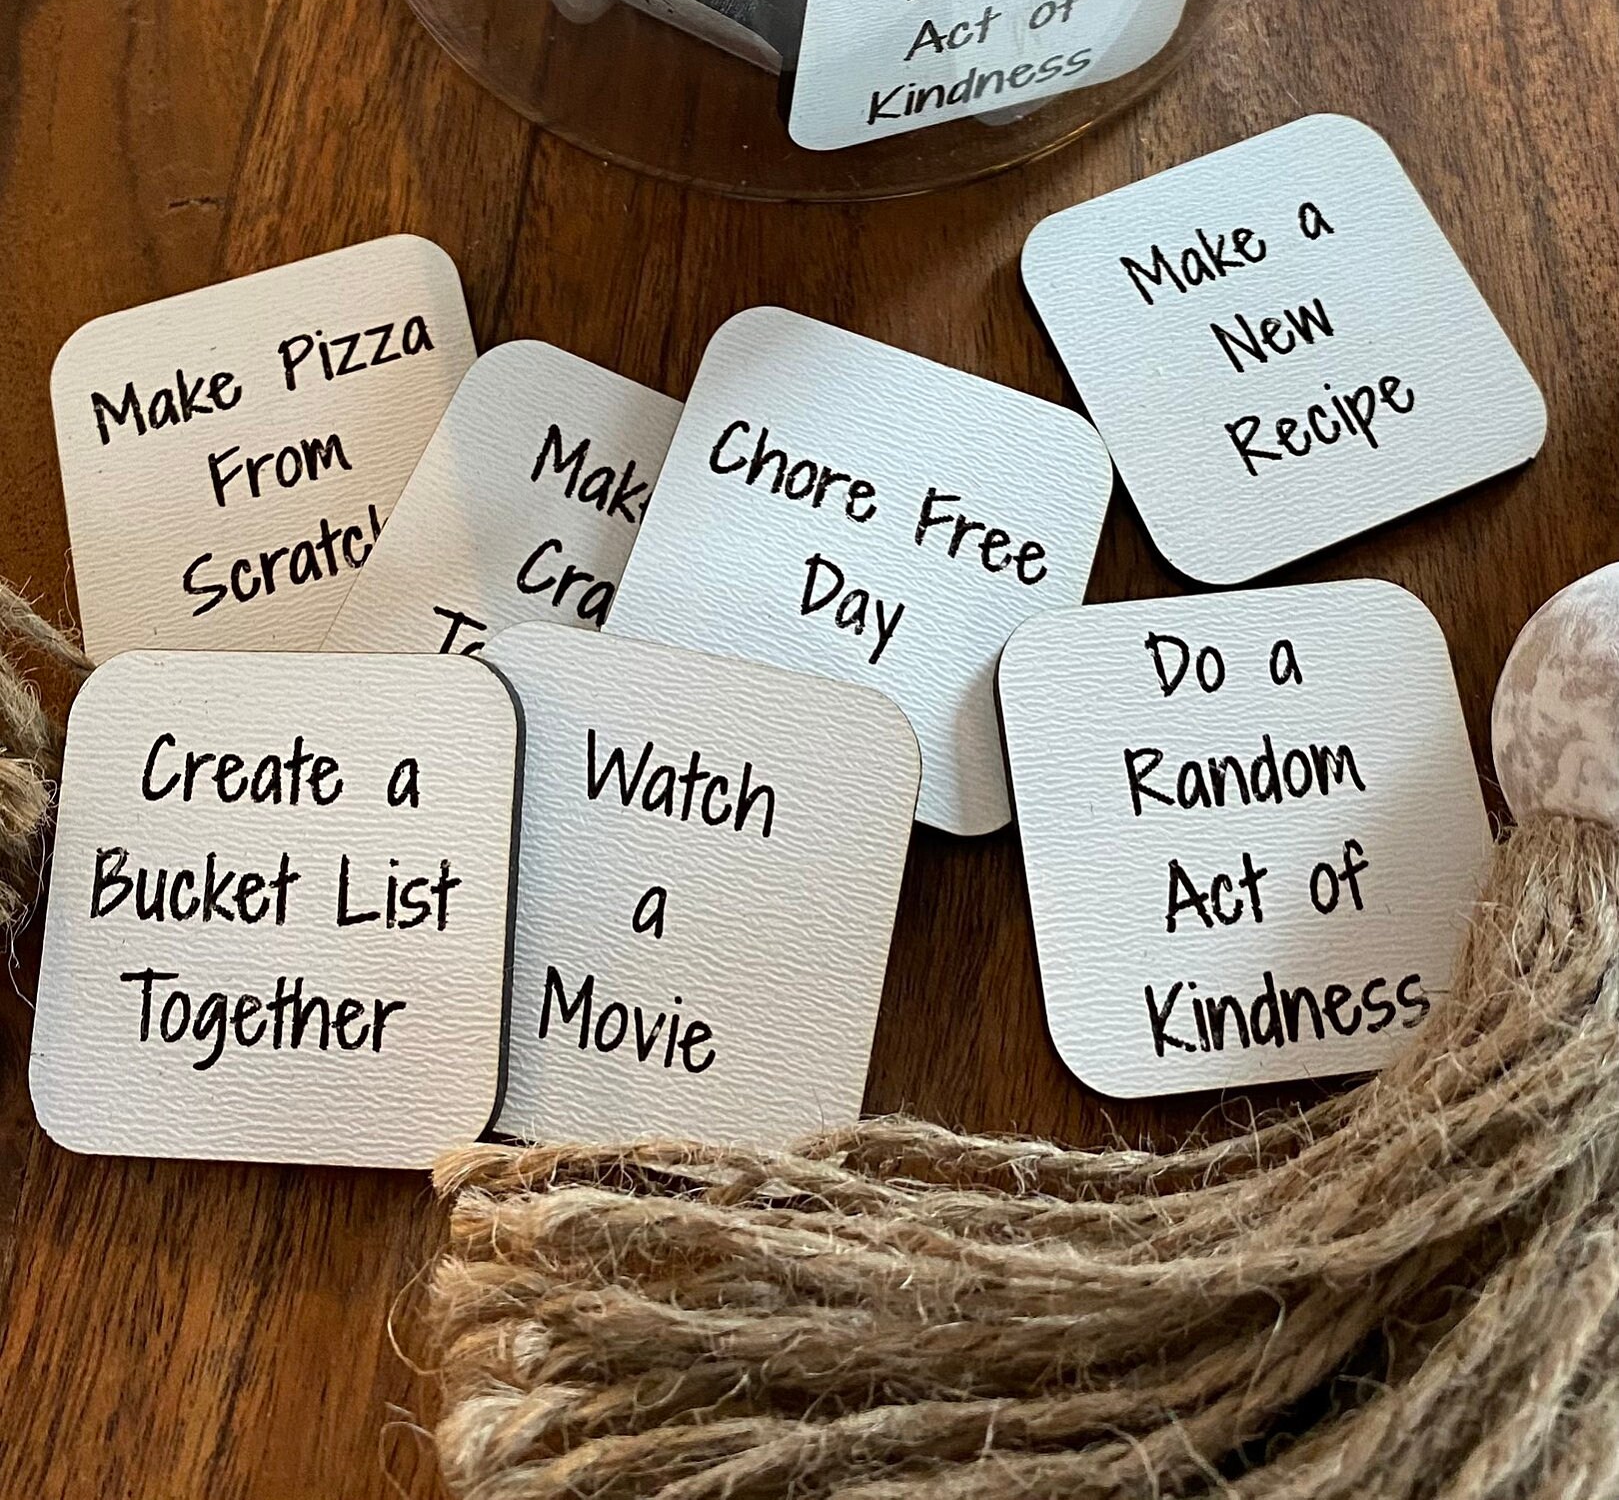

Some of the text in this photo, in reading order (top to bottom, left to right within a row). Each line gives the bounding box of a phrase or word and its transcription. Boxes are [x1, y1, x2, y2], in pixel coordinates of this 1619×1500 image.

[903, 5, 1002, 61] Act
[866, 46, 1093, 126] Kindness
[1119, 201, 1336, 306] Make a
[90, 314, 436, 446] Make Pizza
[1209, 297, 1336, 374] New
[207, 432, 354, 508] From
[1224, 374, 1416, 477] Recipe
[708, 419, 1049, 586] Chore Free
[516, 537, 616, 627] Cra
[800, 552, 905, 665] Day
[1144, 630, 1303, 697] Do a
[141, 732, 421, 809] Create a
[586, 728, 776, 838] Watch
[1123, 733, 1366, 817] Random
[89, 846, 463, 932] Bucket List
[631, 885, 668, 940] a
[1165, 838, 1369, 934] Act of
[119, 967, 407, 1072] Together
[537, 965, 717, 1074] Movie
[1144, 970, 1431, 1058] Kindness
